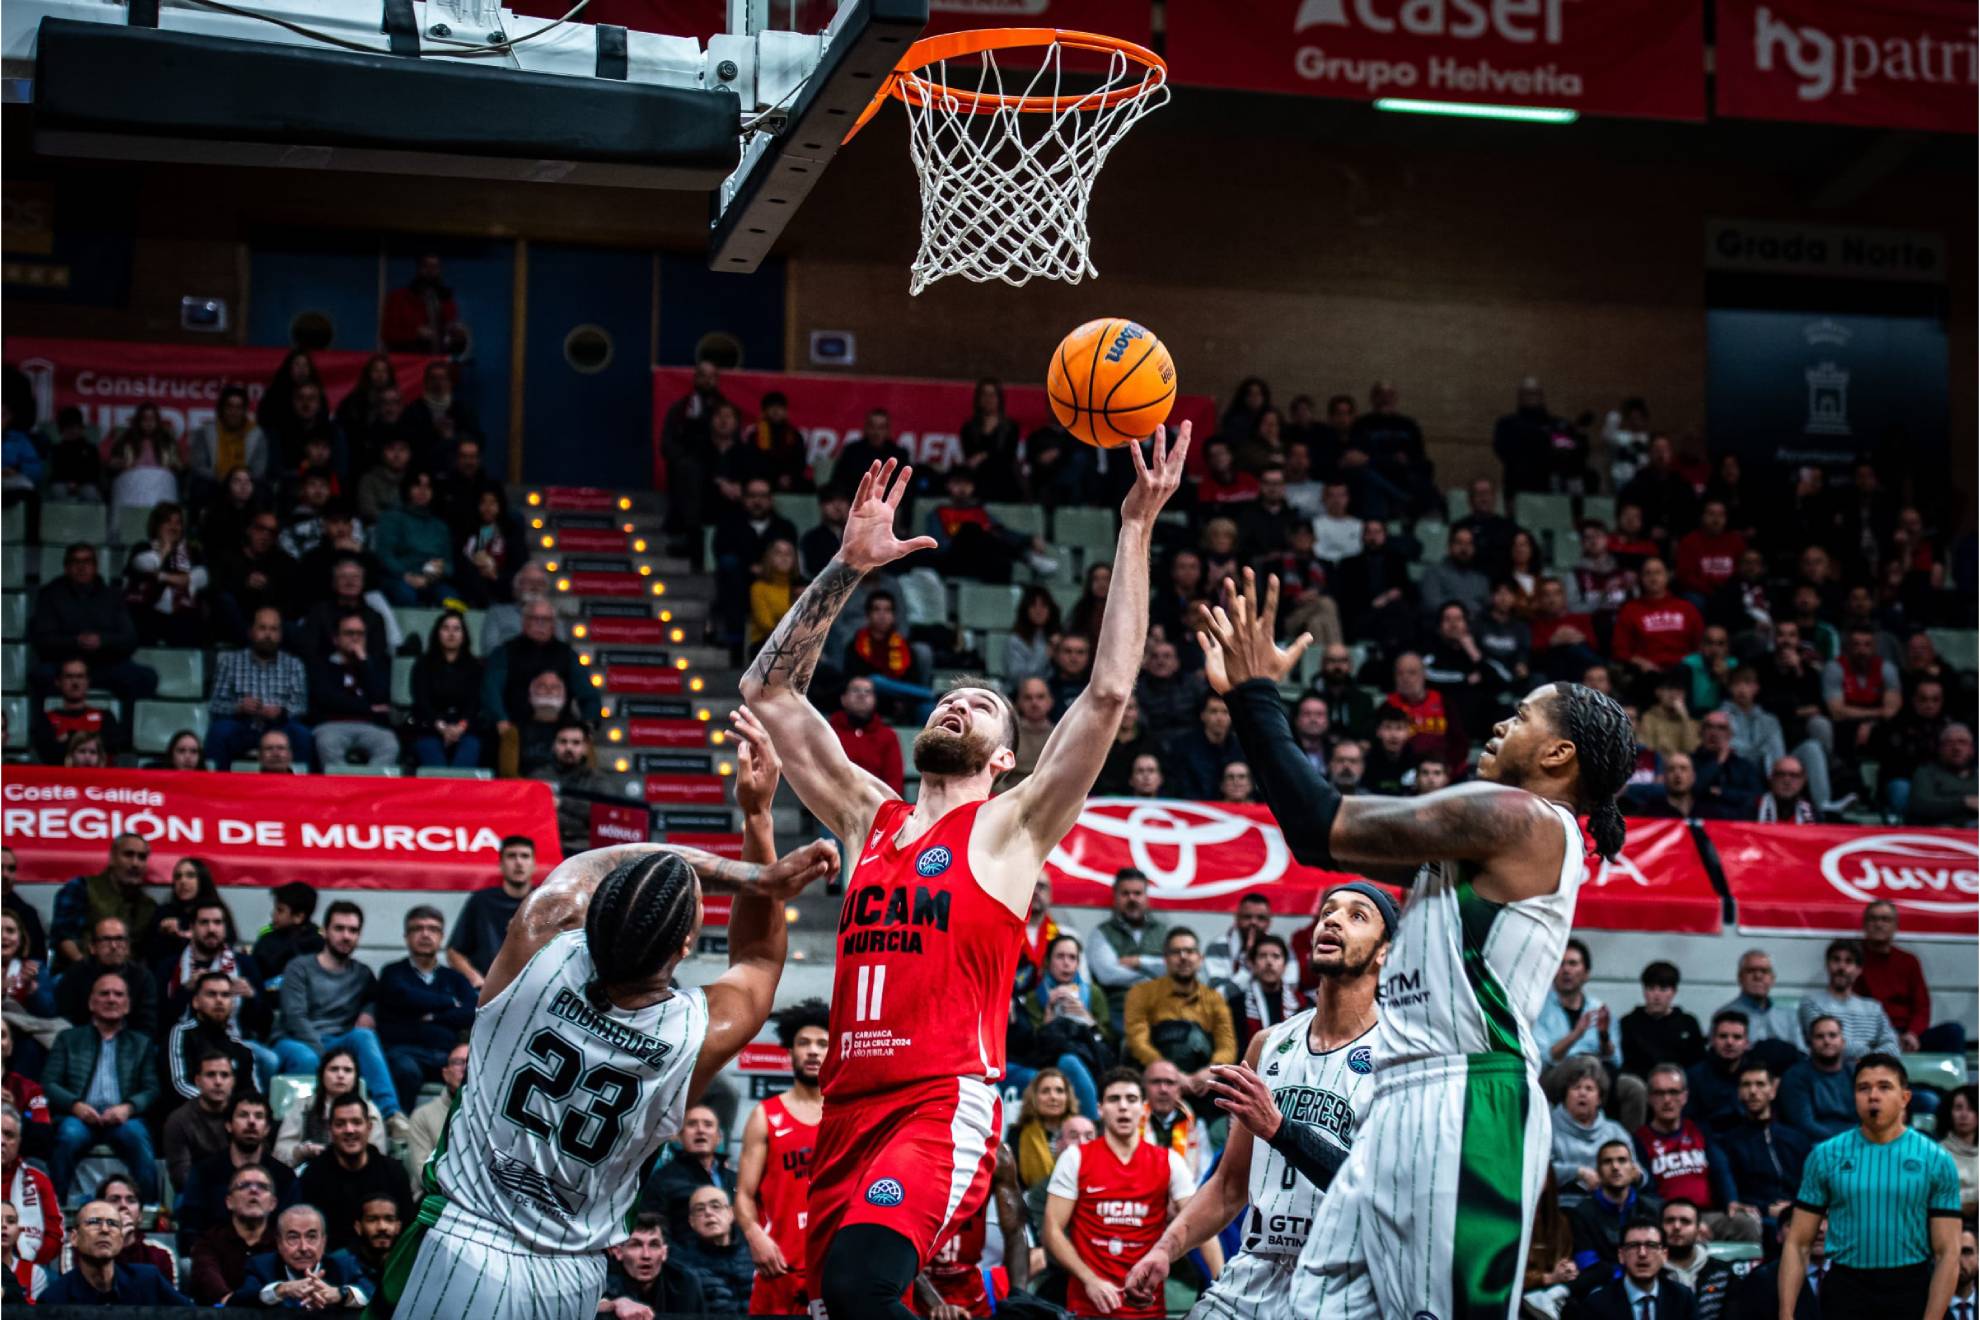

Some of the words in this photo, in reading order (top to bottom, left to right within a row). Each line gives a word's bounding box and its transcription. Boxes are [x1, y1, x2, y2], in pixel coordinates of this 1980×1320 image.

[1295, 46, 1418, 92] Grupo
[1428, 57, 1584, 96] Helvetia
[1716, 228, 1828, 264] Grada
[75, 370, 266, 400] Construccn
[4, 784, 79, 801] Costa
[4, 808, 204, 843] REGIÓN
[218, 819, 288, 847] DE
[302, 823, 500, 852] MURCIA
[597, 824, 643, 842] MÓDULO
[839, 885, 952, 935] UCAM
[843, 930, 923, 958] MURCIA
[856, 964, 886, 1022] 11
[547, 986, 674, 1071] RODRIGUEZ
[854, 1030, 893, 1039] CARAVACA
[853, 1041, 862, 1049] DE
[872, 1039, 890, 1048] CRUZ
[891, 1038, 911, 1047] 2024
[501, 1025, 643, 1168] 23
[1272, 1085, 1356, 1149] NTERRE92
[783, 1147, 813, 1170] UC
[1652, 1148, 1708, 1175] UCAM
[515, 1194, 530, 1208] DE
[1096, 1201, 1149, 1218] UCAM
